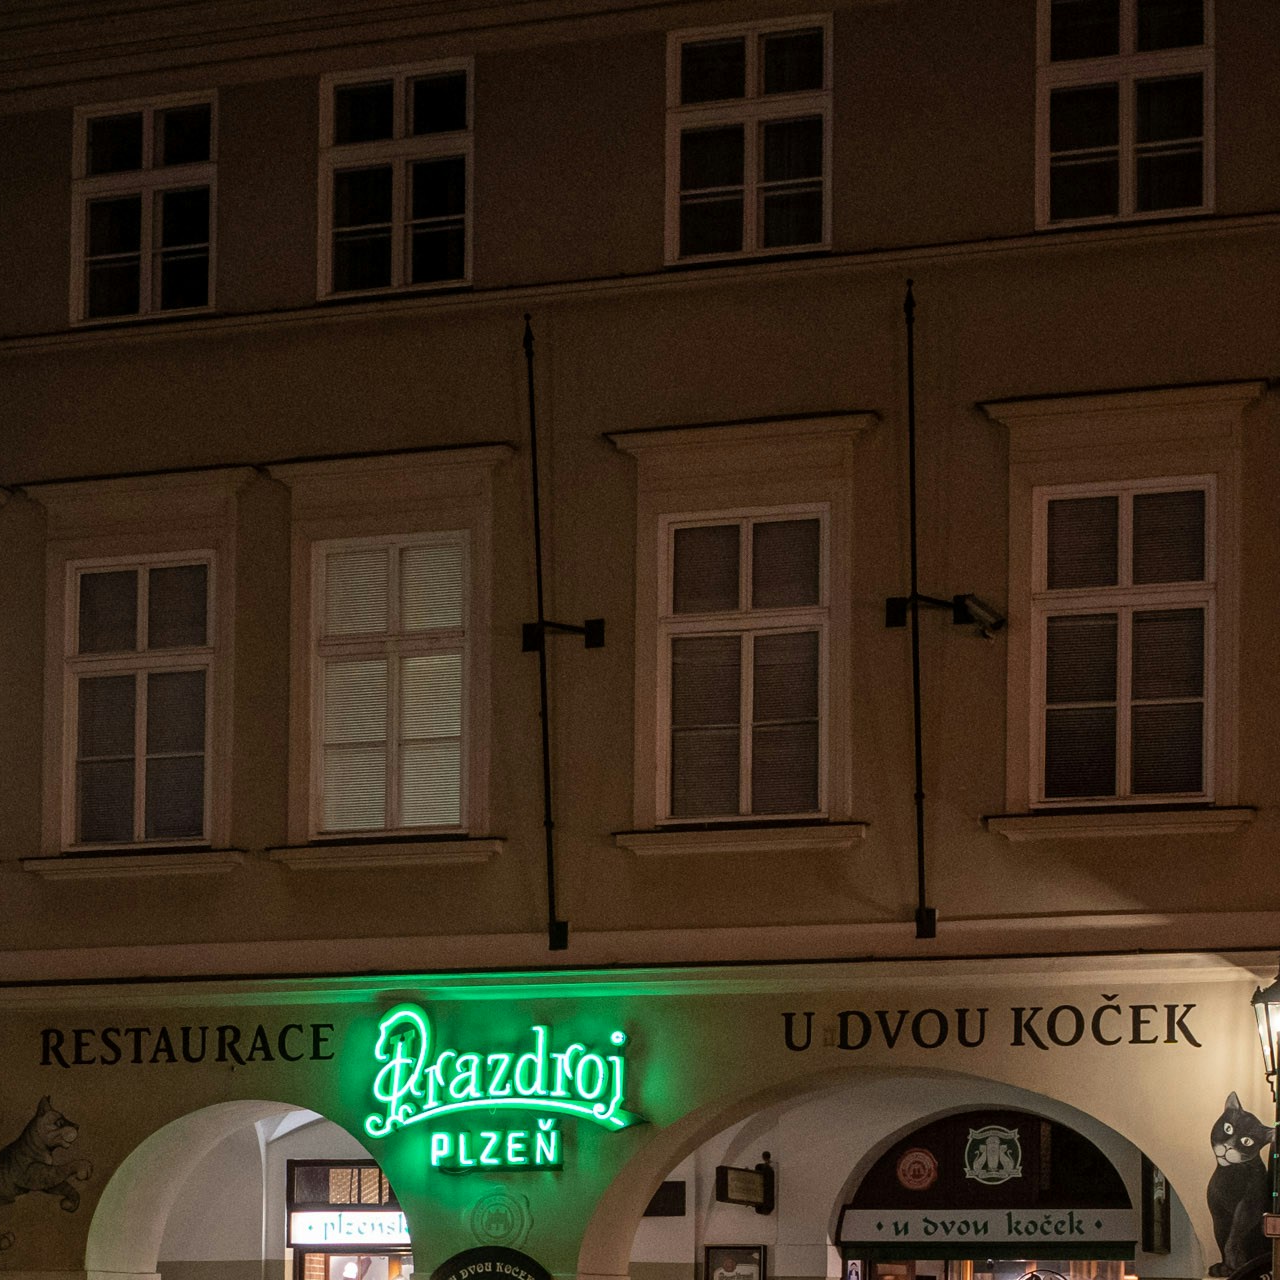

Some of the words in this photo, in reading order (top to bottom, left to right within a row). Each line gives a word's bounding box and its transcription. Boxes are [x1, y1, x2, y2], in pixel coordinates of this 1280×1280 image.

[39, 1023, 335, 1069] RESTAURACE
[782, 1011, 816, 1052] U
[836, 1007, 989, 1050] DVOU
[1010, 993, 1203, 1051] KOČEK
[365, 1003, 626, 1139] Prazdroj
[430, 1117, 561, 1167] PLZEŇ
[892, 1219, 909, 1236] u
[923, 1216, 989, 1237] dvou
[1005, 1211, 1086, 1237] koček
[459, 1261, 493, 1280] DVOU
